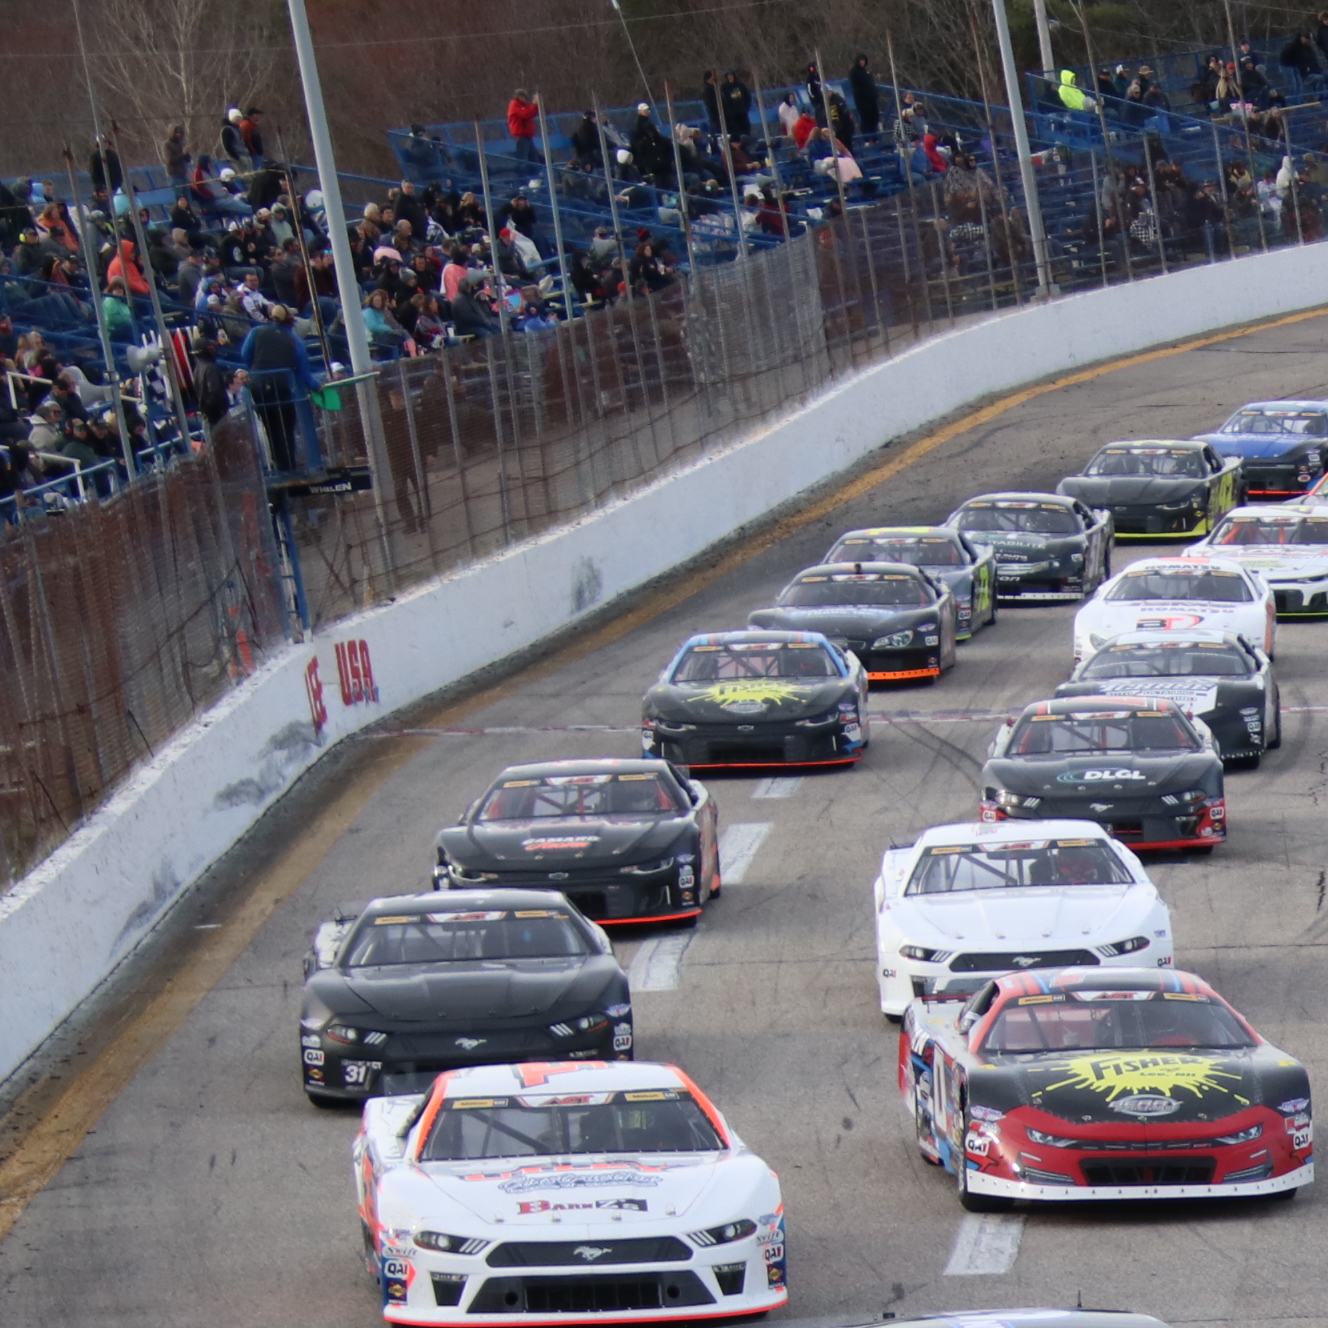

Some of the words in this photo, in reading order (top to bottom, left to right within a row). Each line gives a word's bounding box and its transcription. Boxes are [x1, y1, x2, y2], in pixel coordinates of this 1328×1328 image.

[309, 482, 352, 493] WHELEN
[335, 640, 376, 706] USA
[1084, 770, 1146, 780] DLGL
[345, 1065, 366, 1083] 31
[1090, 1057, 1203, 1081] FISHER
